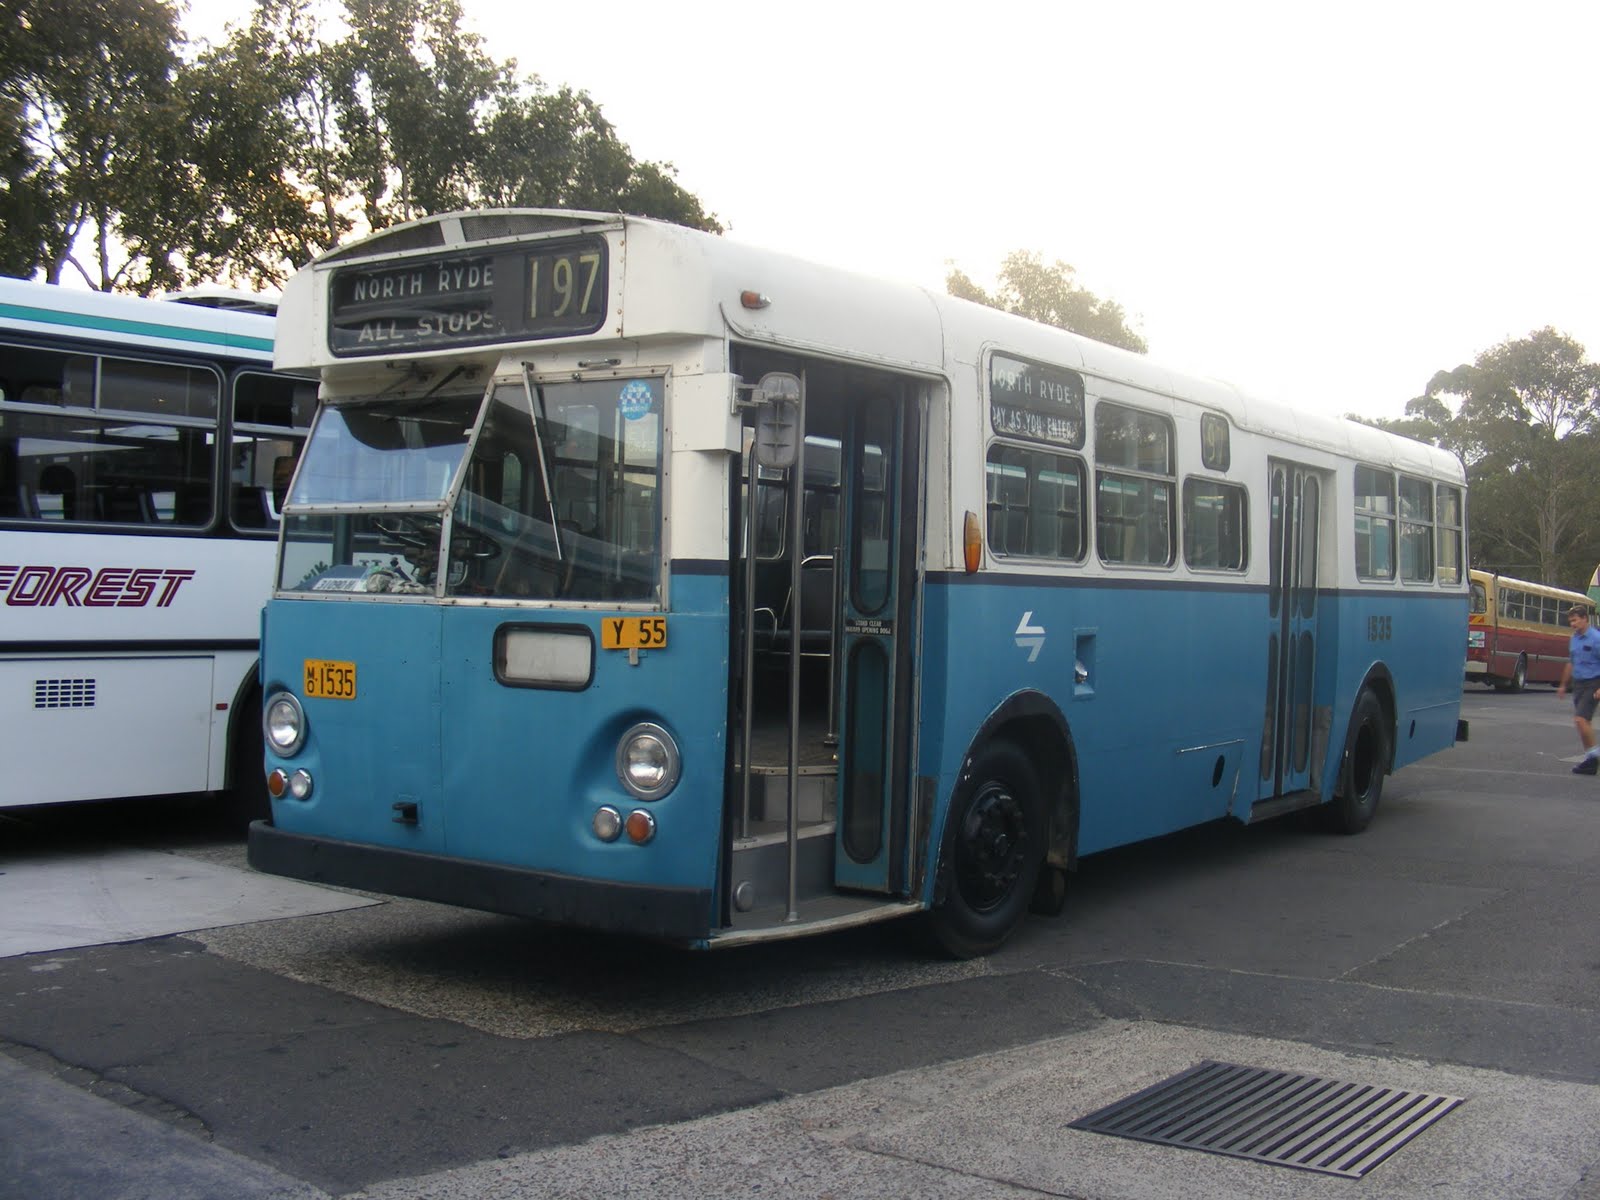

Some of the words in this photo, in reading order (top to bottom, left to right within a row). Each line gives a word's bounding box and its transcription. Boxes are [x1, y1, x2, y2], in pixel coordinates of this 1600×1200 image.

[355, 273, 422, 300] NORTH
[438, 266, 494, 291] RYDE
[530, 254, 600, 319] 197
[358, 321, 404, 343] ALL
[416, 310, 495, 337] STOPS
[1040, 381, 1072, 404] RYDE
[1010, 410, 1021, 429] AS
[1025, 412, 1042, 433] YOU
[613, 619, 624, 645] Y
[639, 619, 665, 645] 55
[1367, 615, 1393, 642] 1535
[320, 667, 353, 697] 1535
